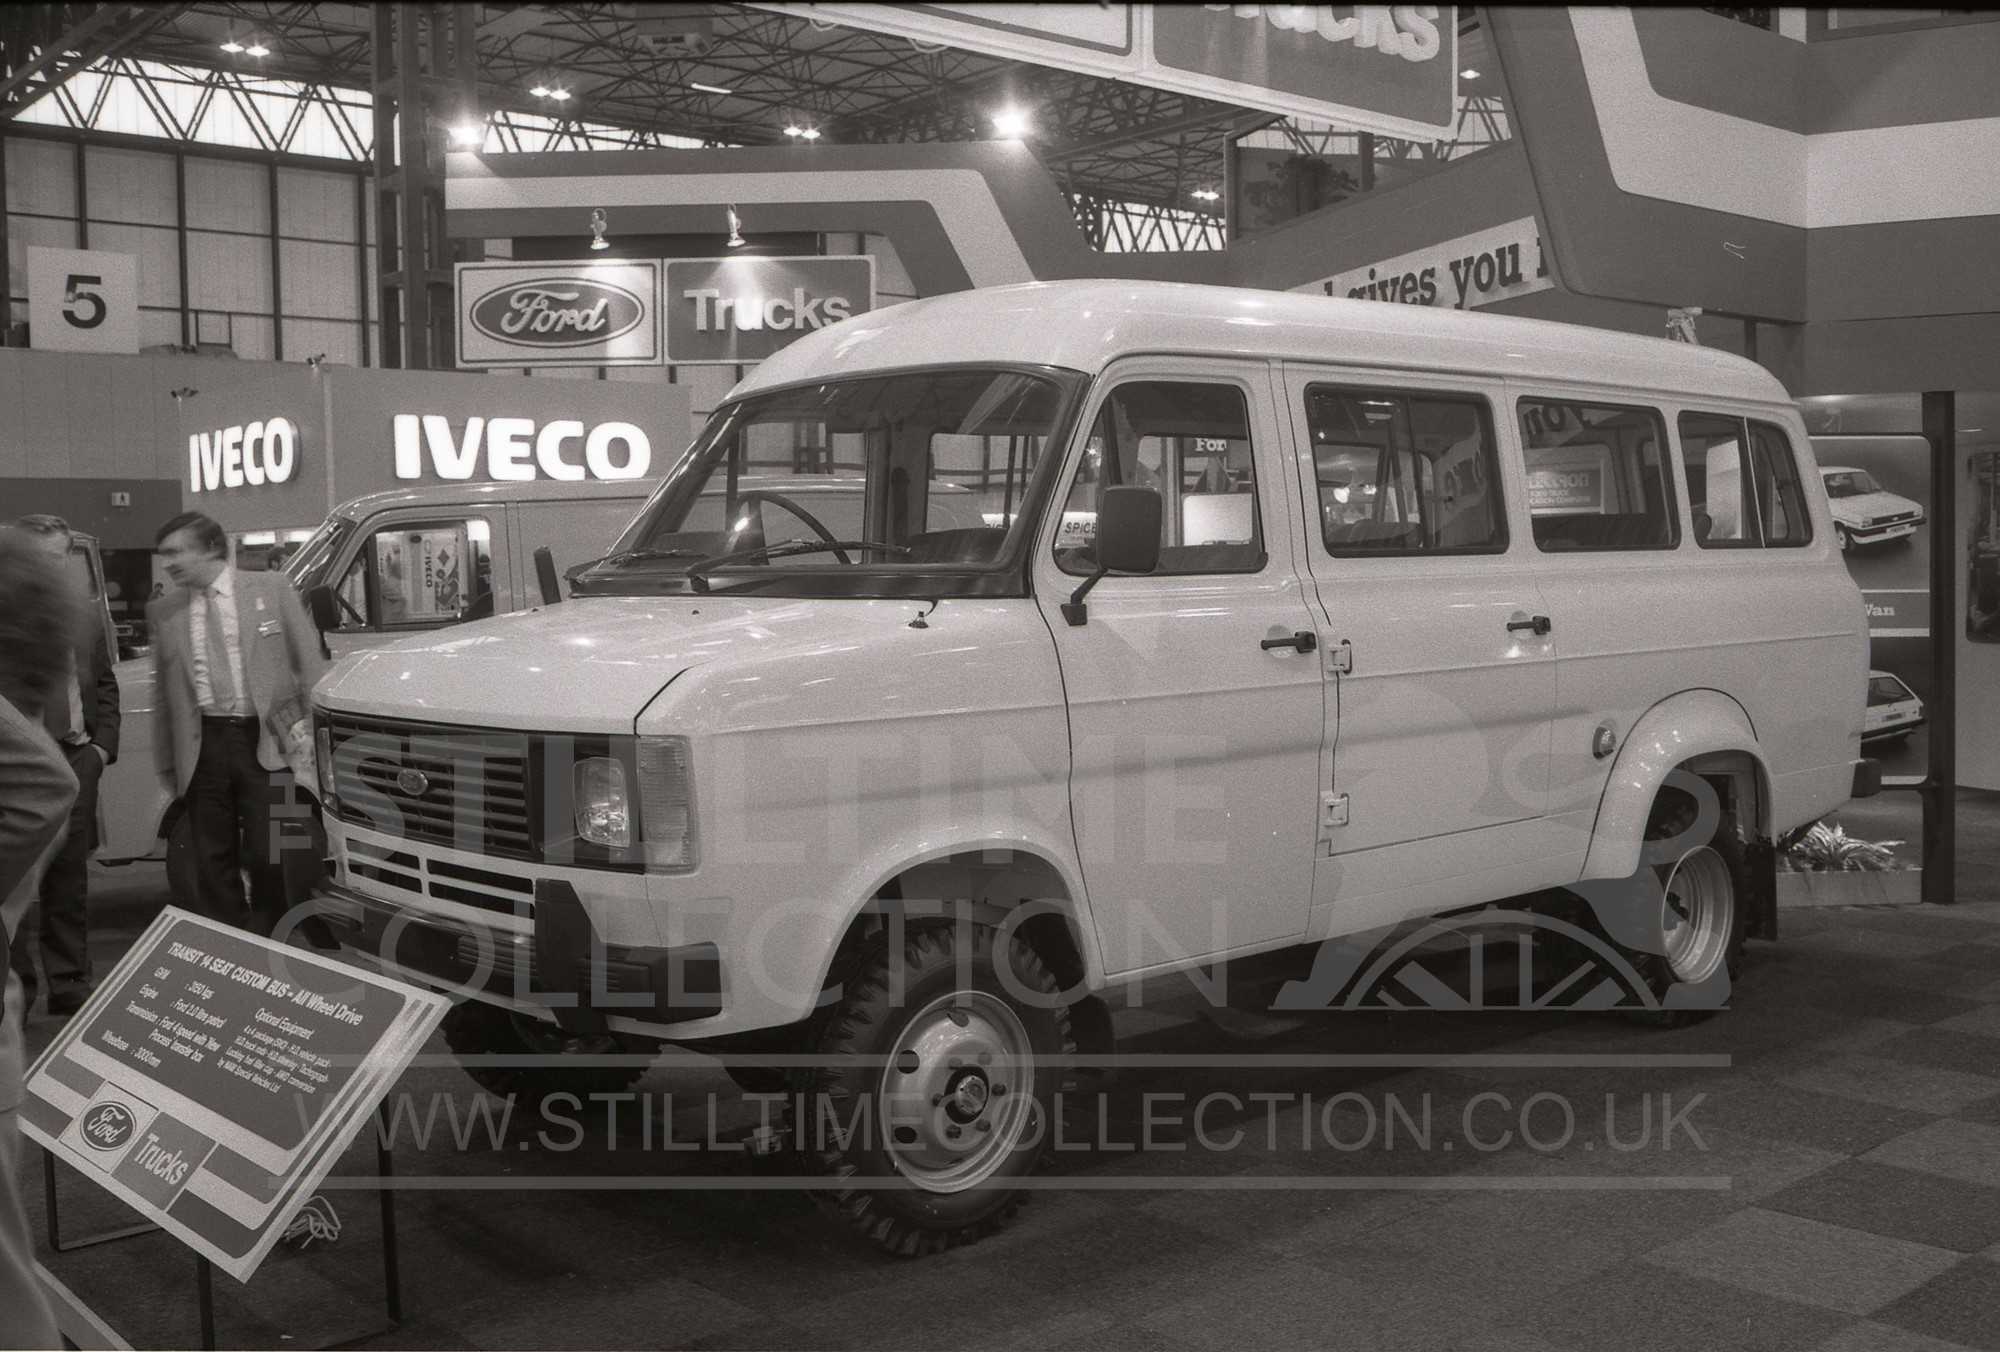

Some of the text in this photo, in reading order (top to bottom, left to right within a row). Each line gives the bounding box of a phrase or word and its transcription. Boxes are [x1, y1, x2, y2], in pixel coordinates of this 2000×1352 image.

[62, 274, 107, 329] 5
[1450, 243, 1522, 310] you
[501, 288, 851, 334] Ford Trucks
[189, 417, 296, 493] IVECO
[394, 414, 652, 481] IVECO
[425, 556, 433, 588] IVECO
[1864, 603, 1896, 617] Van
[167, 941, 205, 964] TRANSIT
[208, 957, 236, 976] SEAT
[230, 966, 272, 990] CUSTOM
[305, 993, 341, 1016] Wheel
[333, 1004, 364, 1026] Drive
[87, 1106, 188, 1184] Ford Trucks
